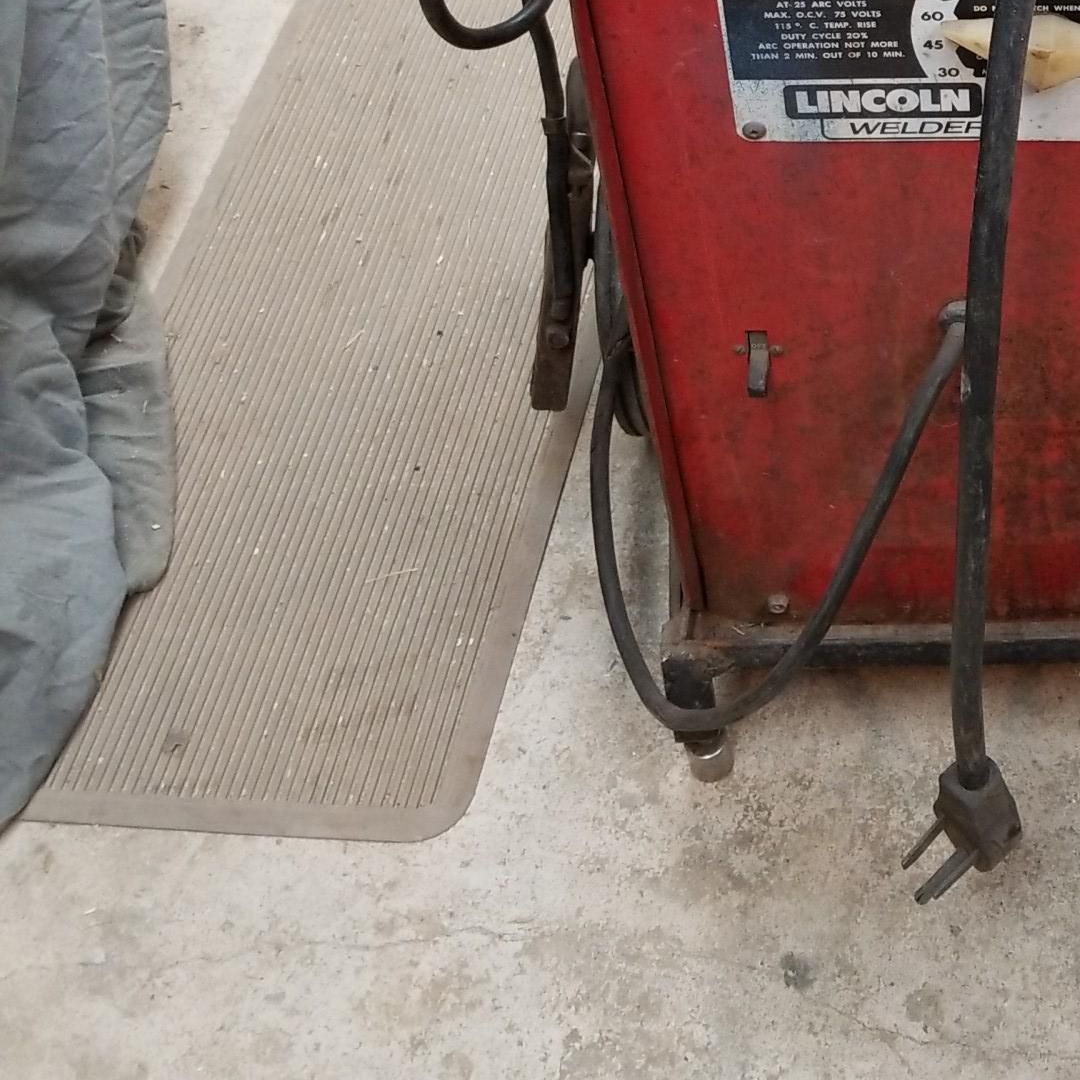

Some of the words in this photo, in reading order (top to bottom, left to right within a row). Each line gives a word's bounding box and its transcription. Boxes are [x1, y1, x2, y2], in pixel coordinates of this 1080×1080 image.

[793, 0, 806, 8] 25
[811, 0, 832, 8] ARC
[836, 0, 868, 8] VOLTS
[1054, 4, 1080, 12] WHEN
[764, 11, 791, 19] MAX.
[796, 10, 826, 19] O.C.V.
[833, 10, 846, 18] 75
[850, 10, 882, 18] VOLTS
[920, 11, 944, 21] 60
[824, 21, 852, 29] TEMP.
[781, 32, 807, 40] DUTY
[812, 32, 841, 40] CYCLE
[758, 42, 779, 50] ARC
[783, 41, 840, 49] OPERATION
[844, 41, 866, 49] NOT
[923, 40, 944, 50] 45
[752, 52, 779, 60] THAN
[822, 51, 843, 59] OUT
[883, 50, 906, 58] MIN.
[938, 67, 960, 77] 30
[795, 88, 971, 114] LINCOLN
